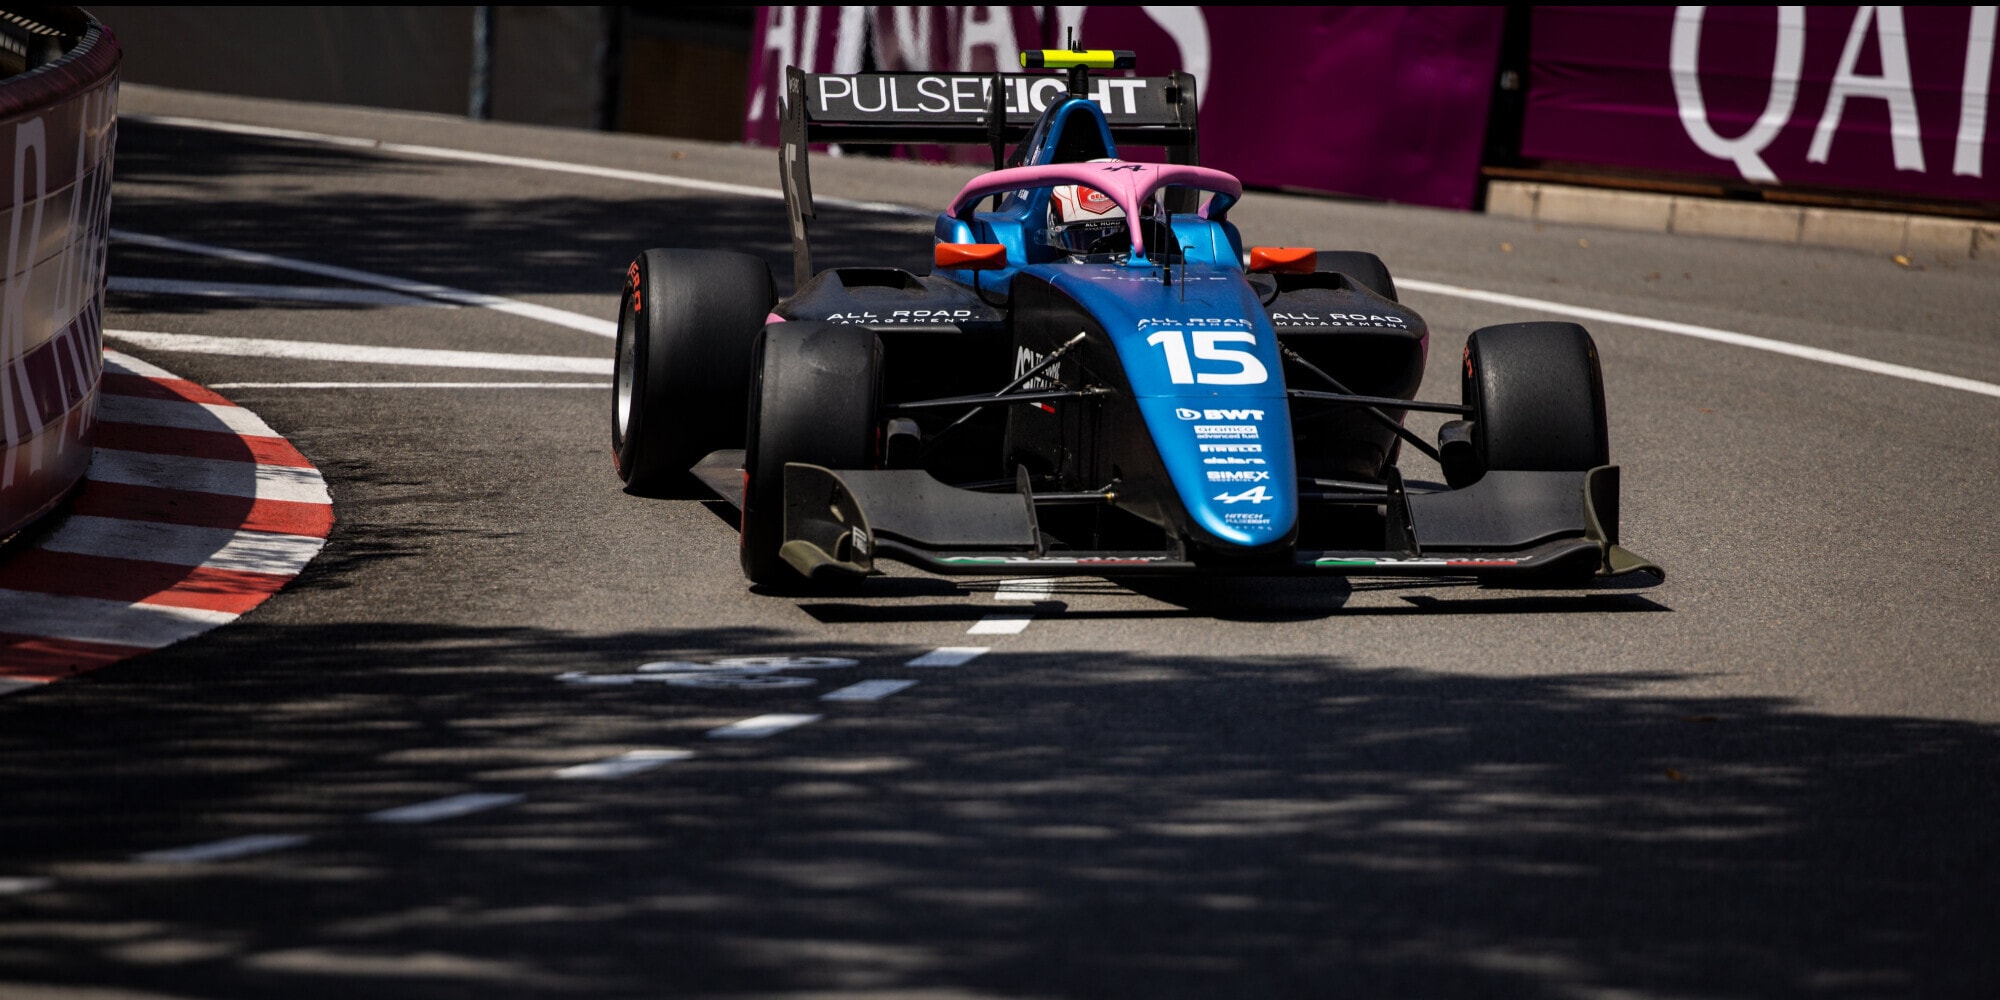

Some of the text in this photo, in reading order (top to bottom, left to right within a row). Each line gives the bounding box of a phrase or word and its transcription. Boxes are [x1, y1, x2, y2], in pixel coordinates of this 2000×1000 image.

[827, 311, 878, 321] ALL
[1272, 312, 1403, 323] ALL ROAD
[1138, 318, 1253, 328] ALL ROAD
[1275, 321, 1408, 330] MANAGEMENT
[1146, 330, 1269, 386] 15
[1203, 409, 1265, 421] BWT
[1203, 456, 1266, 464] dallara
[1206, 471, 1270, 482] SIMEX
